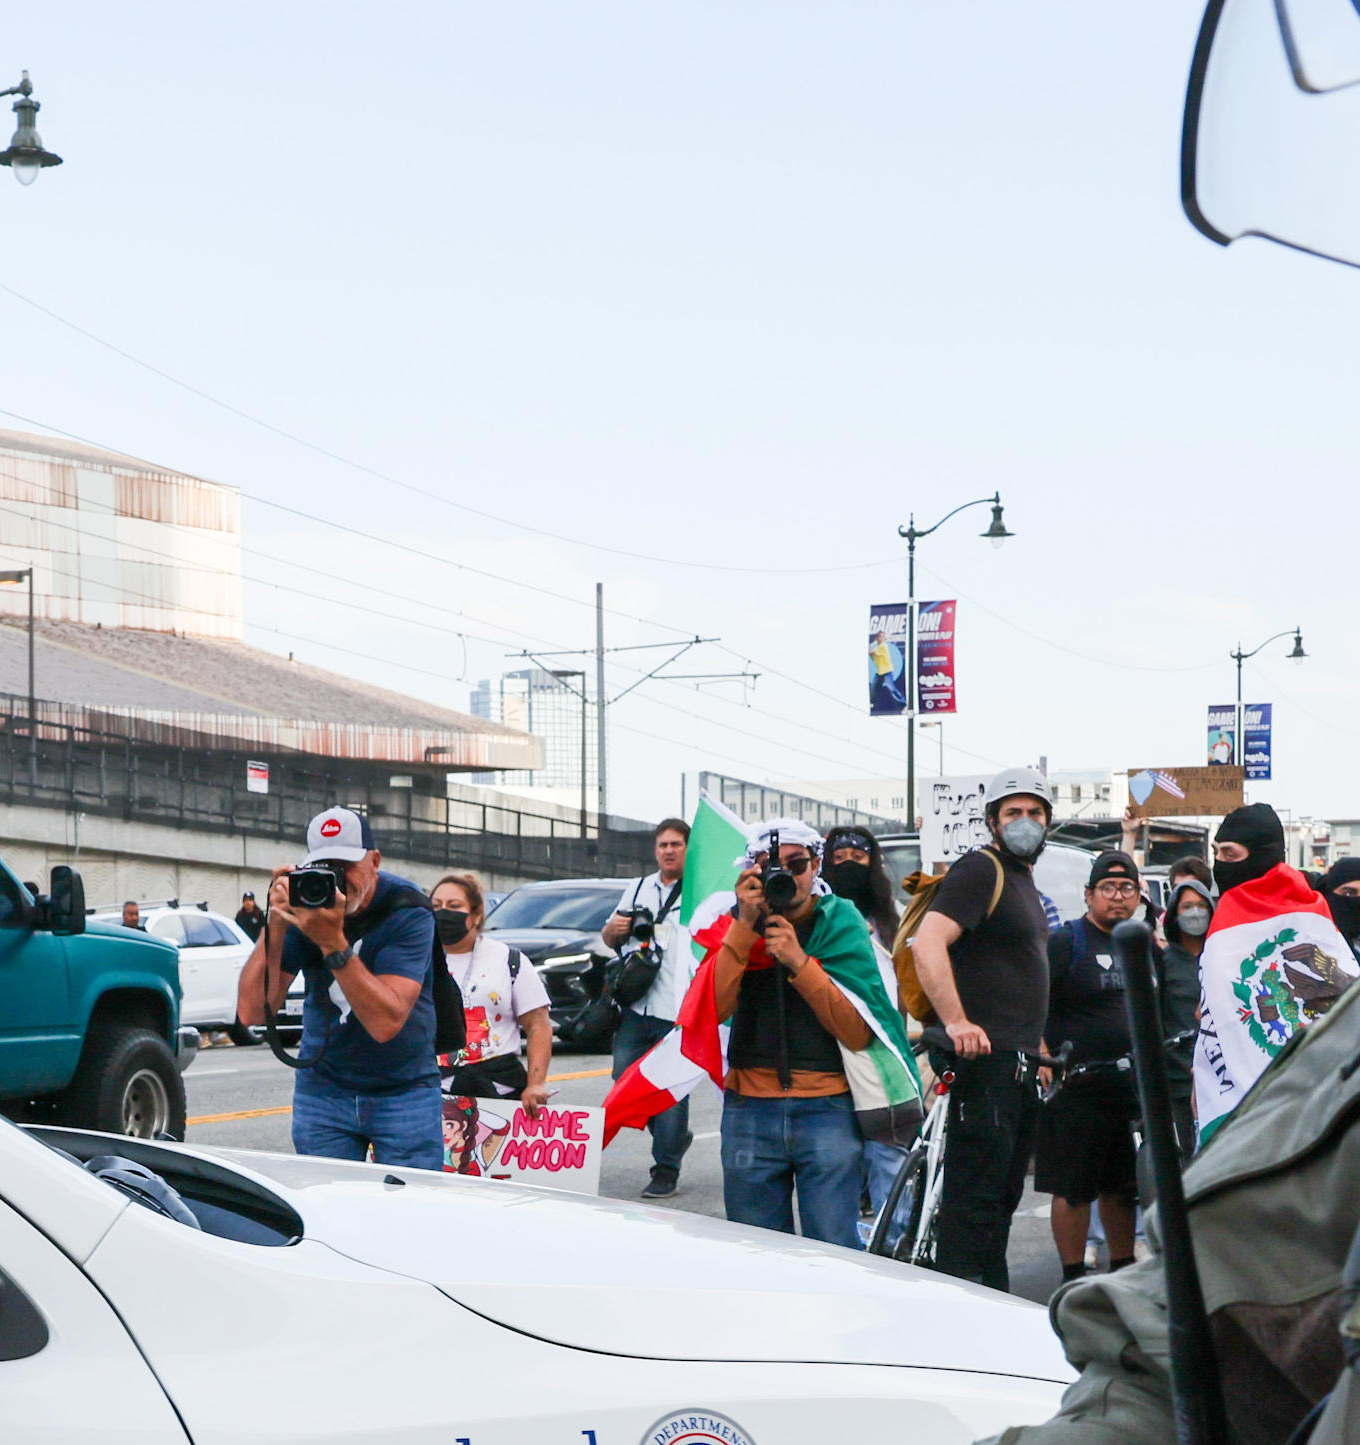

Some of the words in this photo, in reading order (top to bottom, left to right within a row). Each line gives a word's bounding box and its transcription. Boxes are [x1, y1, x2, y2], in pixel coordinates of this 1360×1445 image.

[918, 612, 943, 632] ON!
[511, 1106, 591, 1141] NAME
[500, 1138, 587, 1173] MOON
